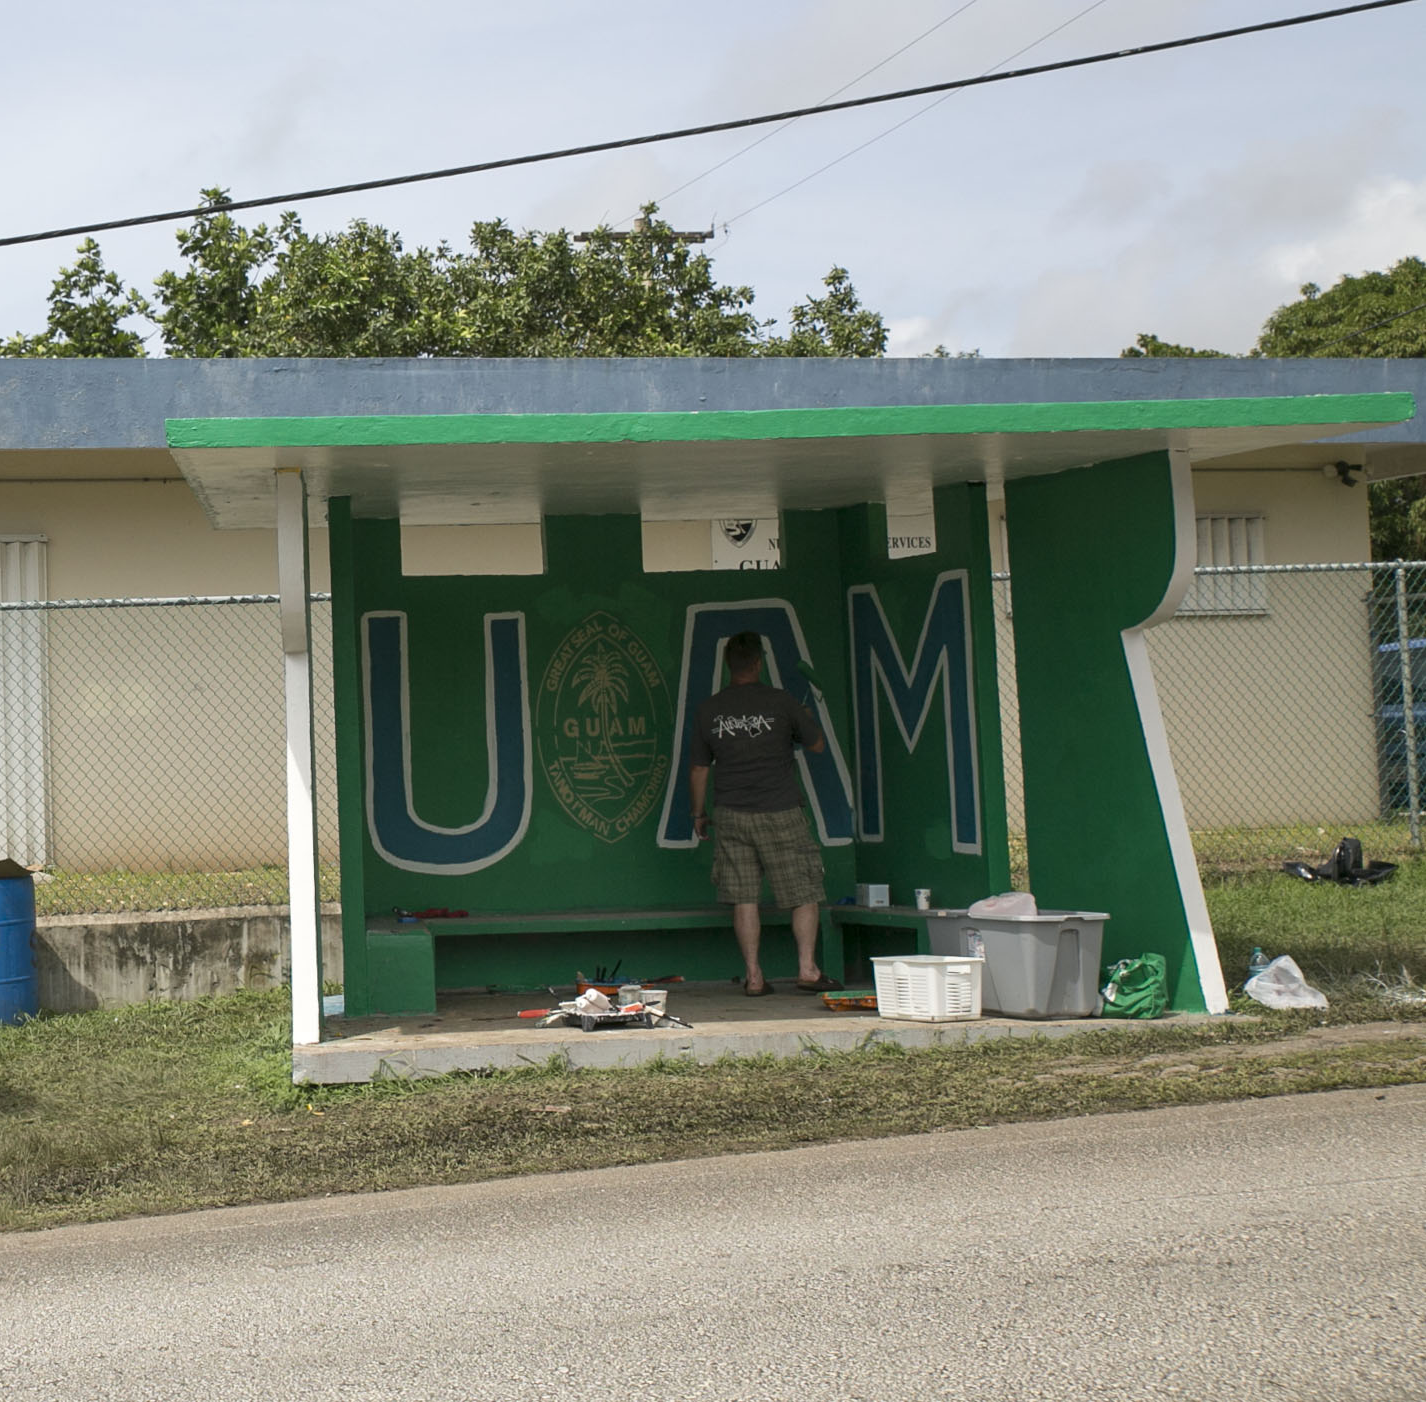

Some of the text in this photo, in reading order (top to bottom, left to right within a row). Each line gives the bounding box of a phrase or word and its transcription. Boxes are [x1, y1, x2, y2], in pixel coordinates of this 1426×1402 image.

[546, 619, 661, 691] GREAT SEAL OF GUAM
[563, 716, 647, 738] GUAM
[615, 755, 668, 832] CHAMORRO
